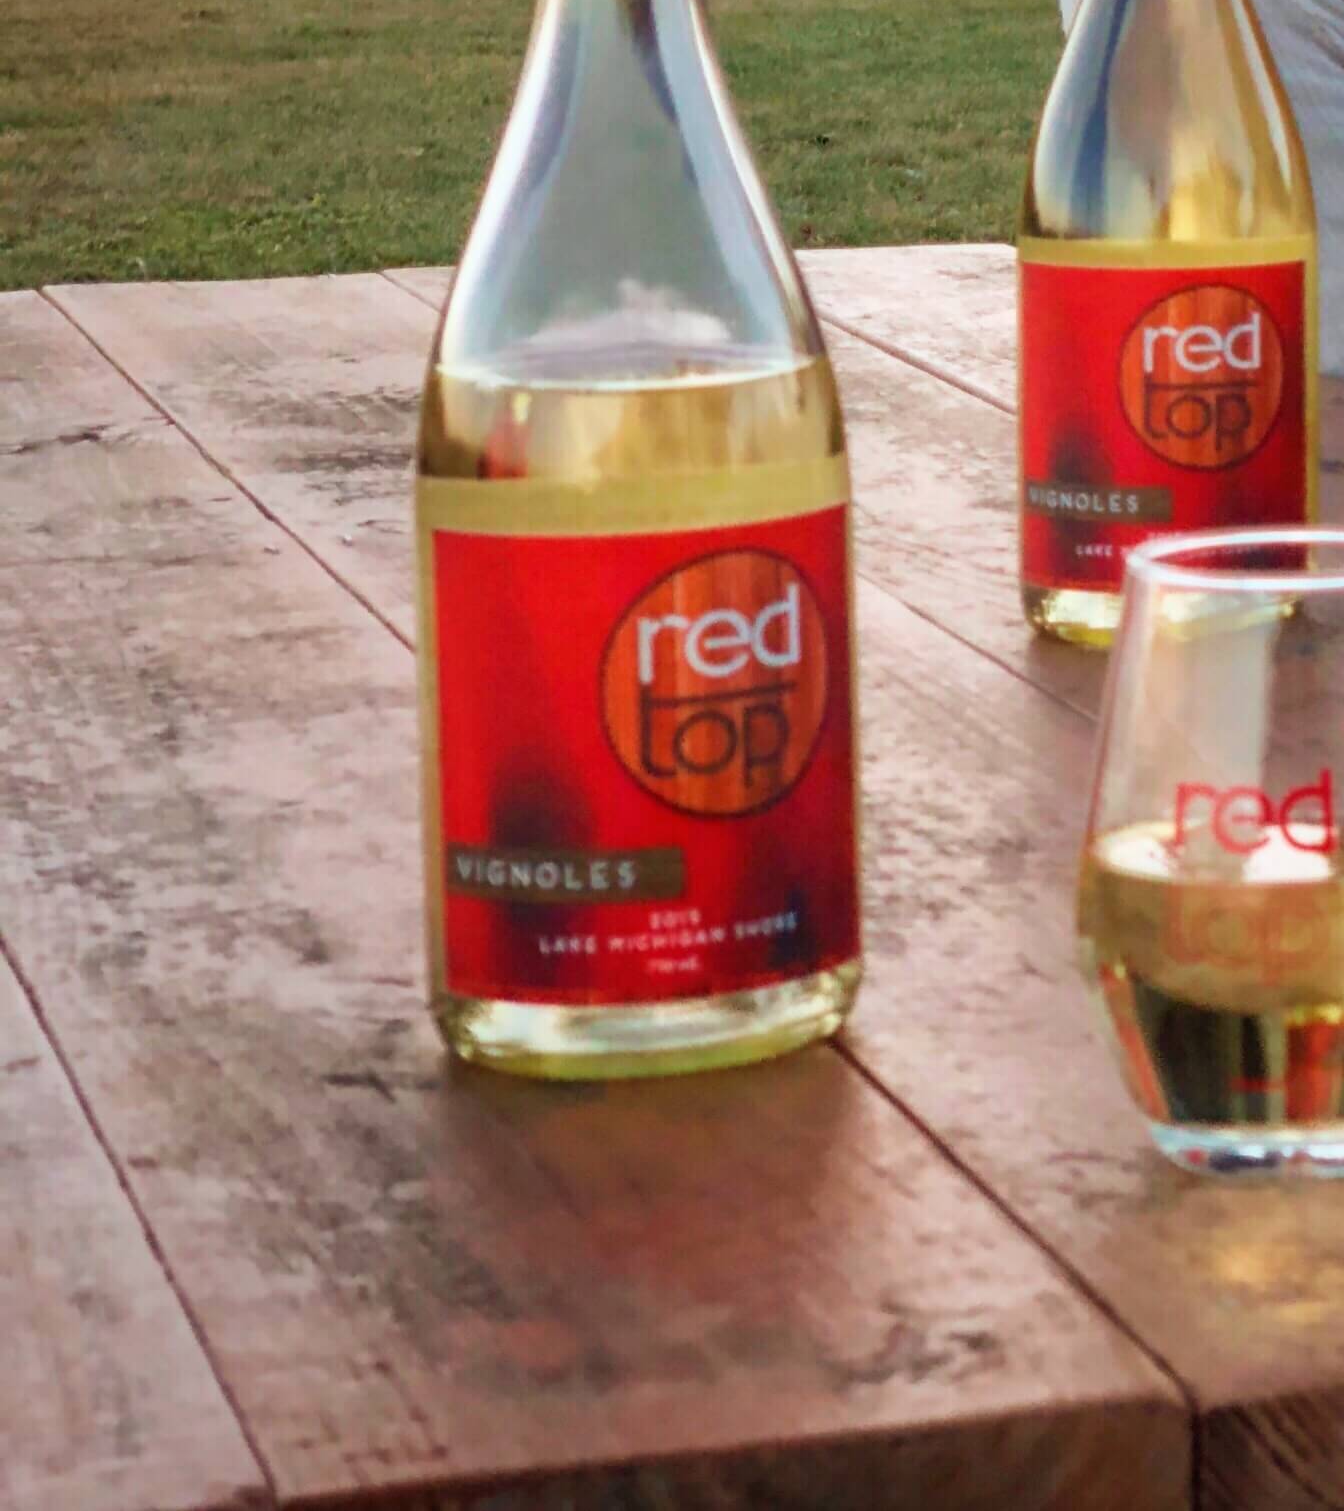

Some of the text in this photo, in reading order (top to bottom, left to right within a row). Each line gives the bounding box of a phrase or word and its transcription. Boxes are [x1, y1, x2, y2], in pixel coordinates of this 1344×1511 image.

[1142, 312, 1262, 373] red
[1143, 376, 1260, 452] top
[637, 583, 802, 686] red
[640, 680, 797, 789] top
[1174, 767, 1338, 854] red
[456, 853, 636, 891] VIGNOLES
[538, 910, 798, 955] LAKE MICHIGAN SHORE
